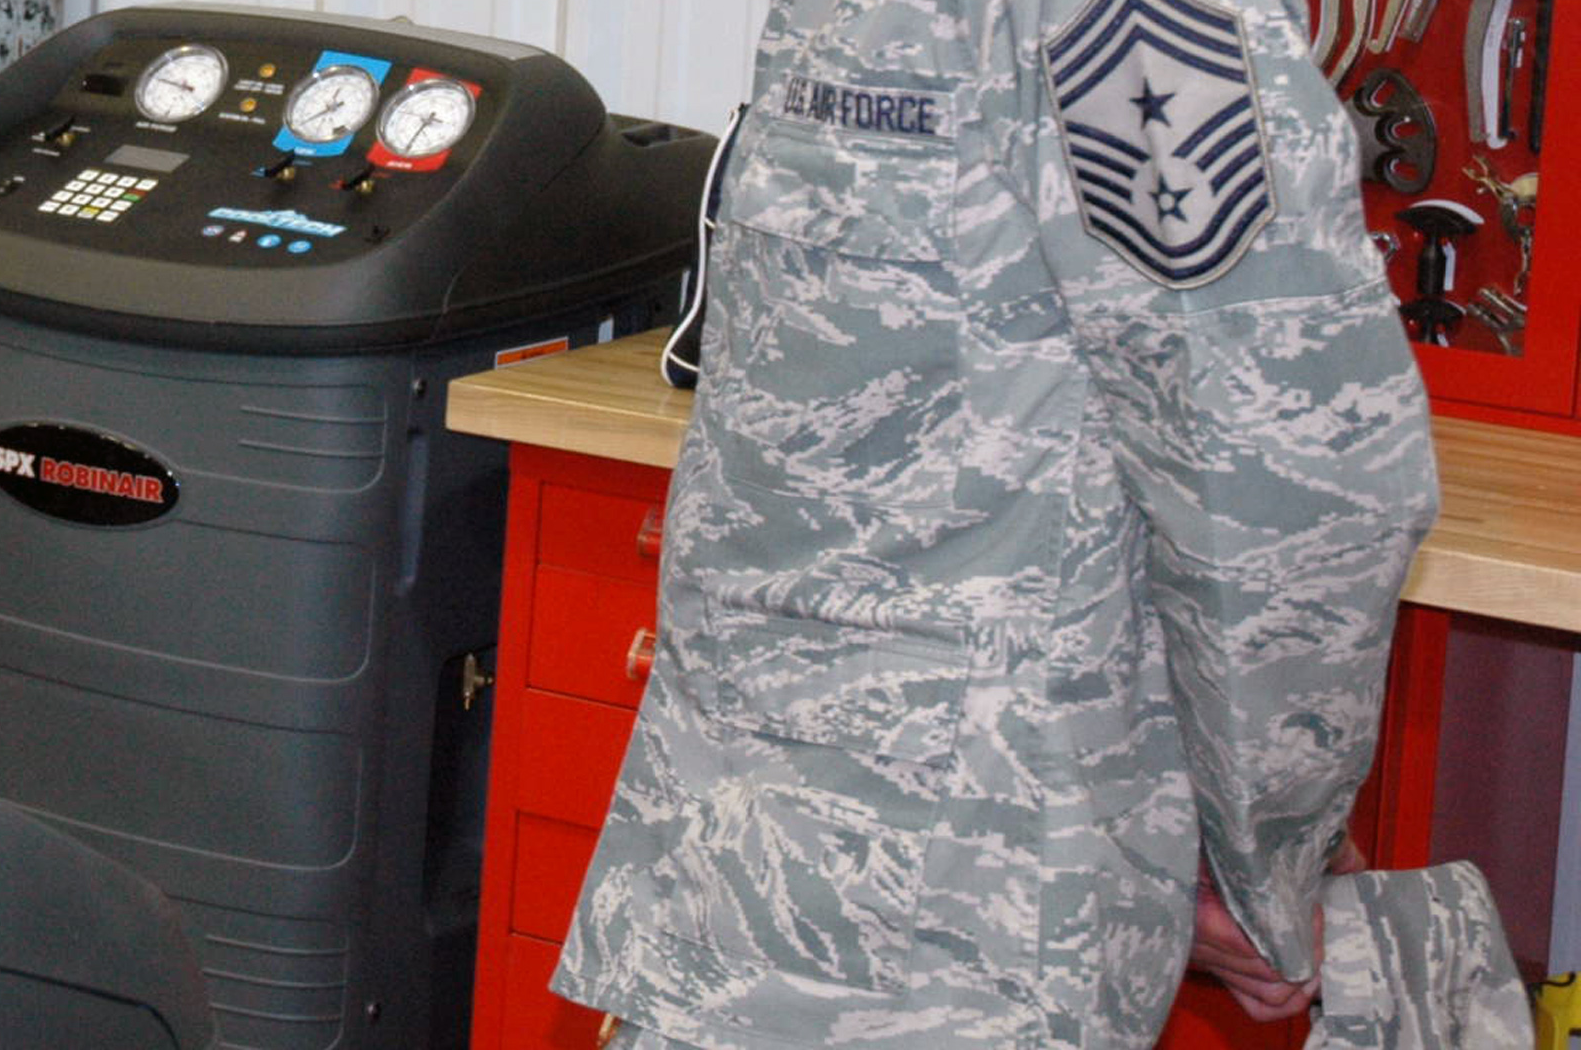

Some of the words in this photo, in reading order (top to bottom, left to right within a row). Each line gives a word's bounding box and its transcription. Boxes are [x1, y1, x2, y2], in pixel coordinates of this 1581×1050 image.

[807, 82, 837, 125] AIR
[839, 89, 936, 135] FORCE
[39, 456, 164, 503] ROBINAIR
